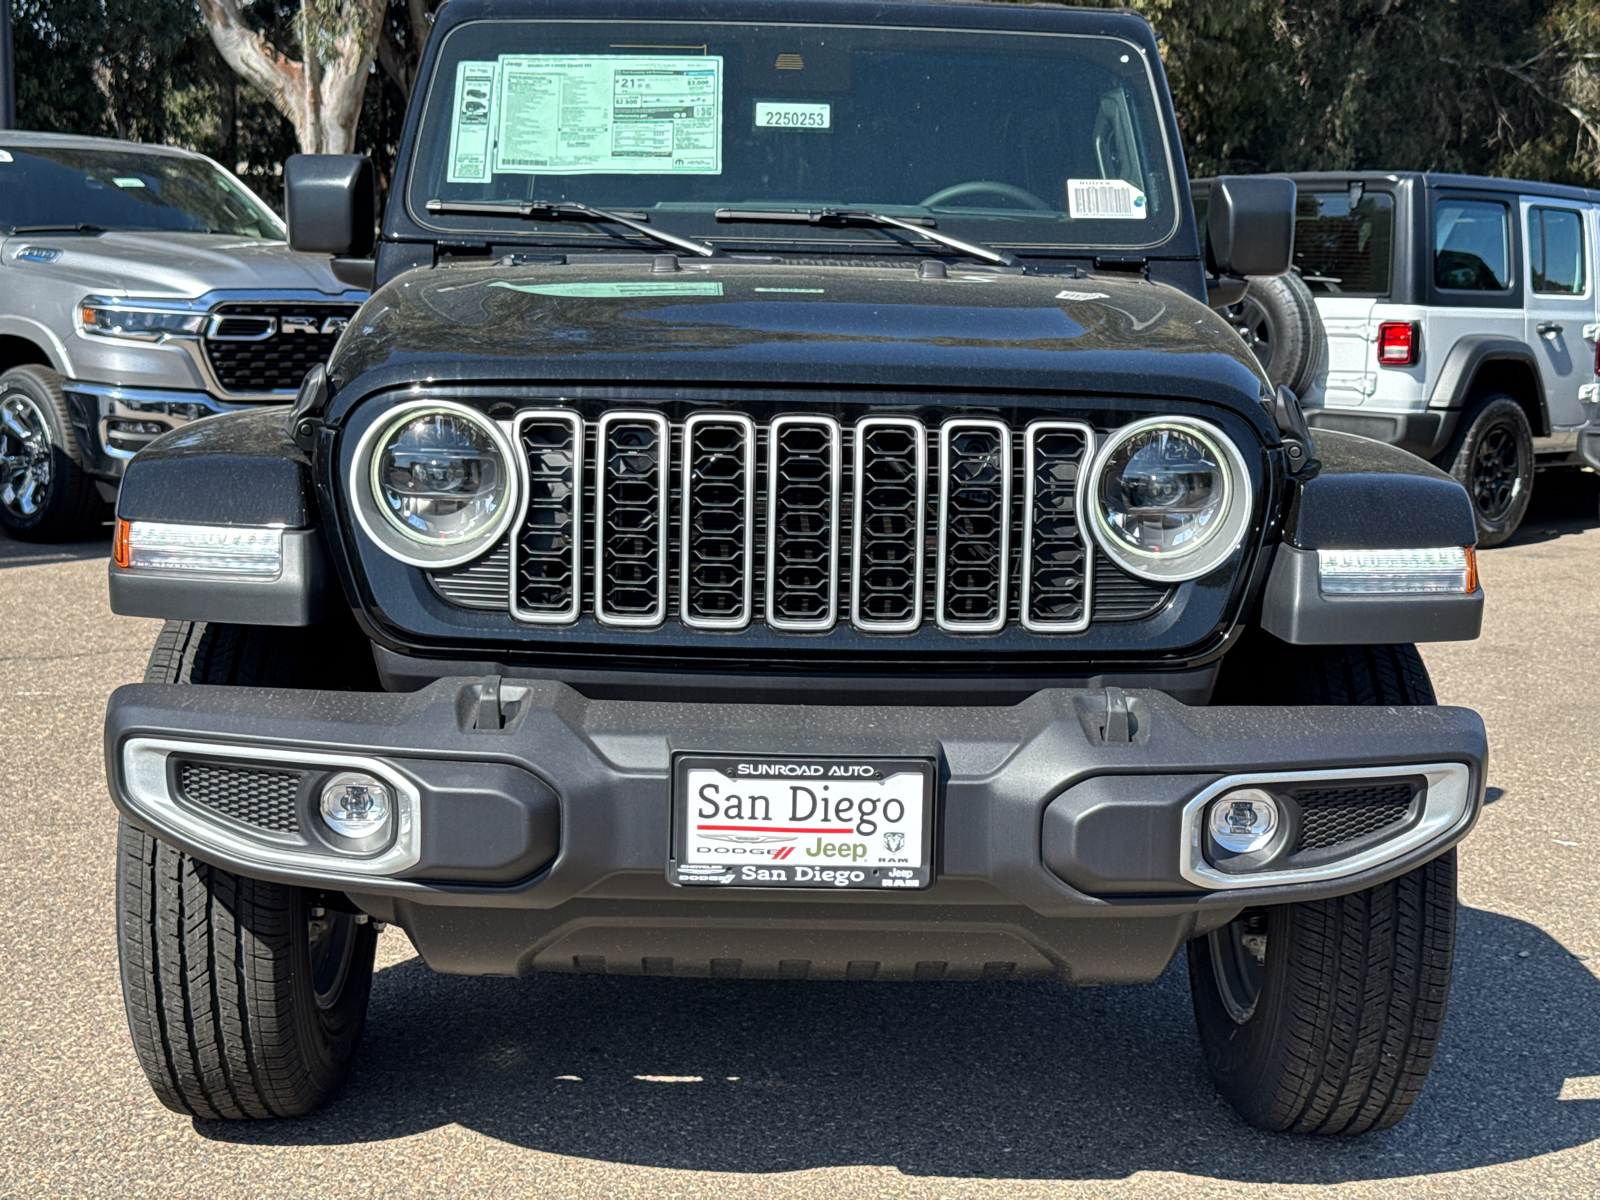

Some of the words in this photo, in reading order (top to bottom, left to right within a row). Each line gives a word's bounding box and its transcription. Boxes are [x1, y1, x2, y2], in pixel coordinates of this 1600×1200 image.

[621, 78, 635, 88] 21
[766, 111, 825, 126] 2250253
[281, 316, 351, 334] RA
[737, 763, 824, 776] SUNROAD
[827, 765, 874, 777] AUTO
[698, 783, 773, 821] San
[788, 784, 905, 836] Diego
[696, 846, 781, 855] DODGE
[805, 837, 868, 862] Jeep
[741, 865, 788, 881] San
[794, 866, 865, 886] Diego
[888, 867, 914, 879] Jeep
[881, 879, 920, 887] RAM
